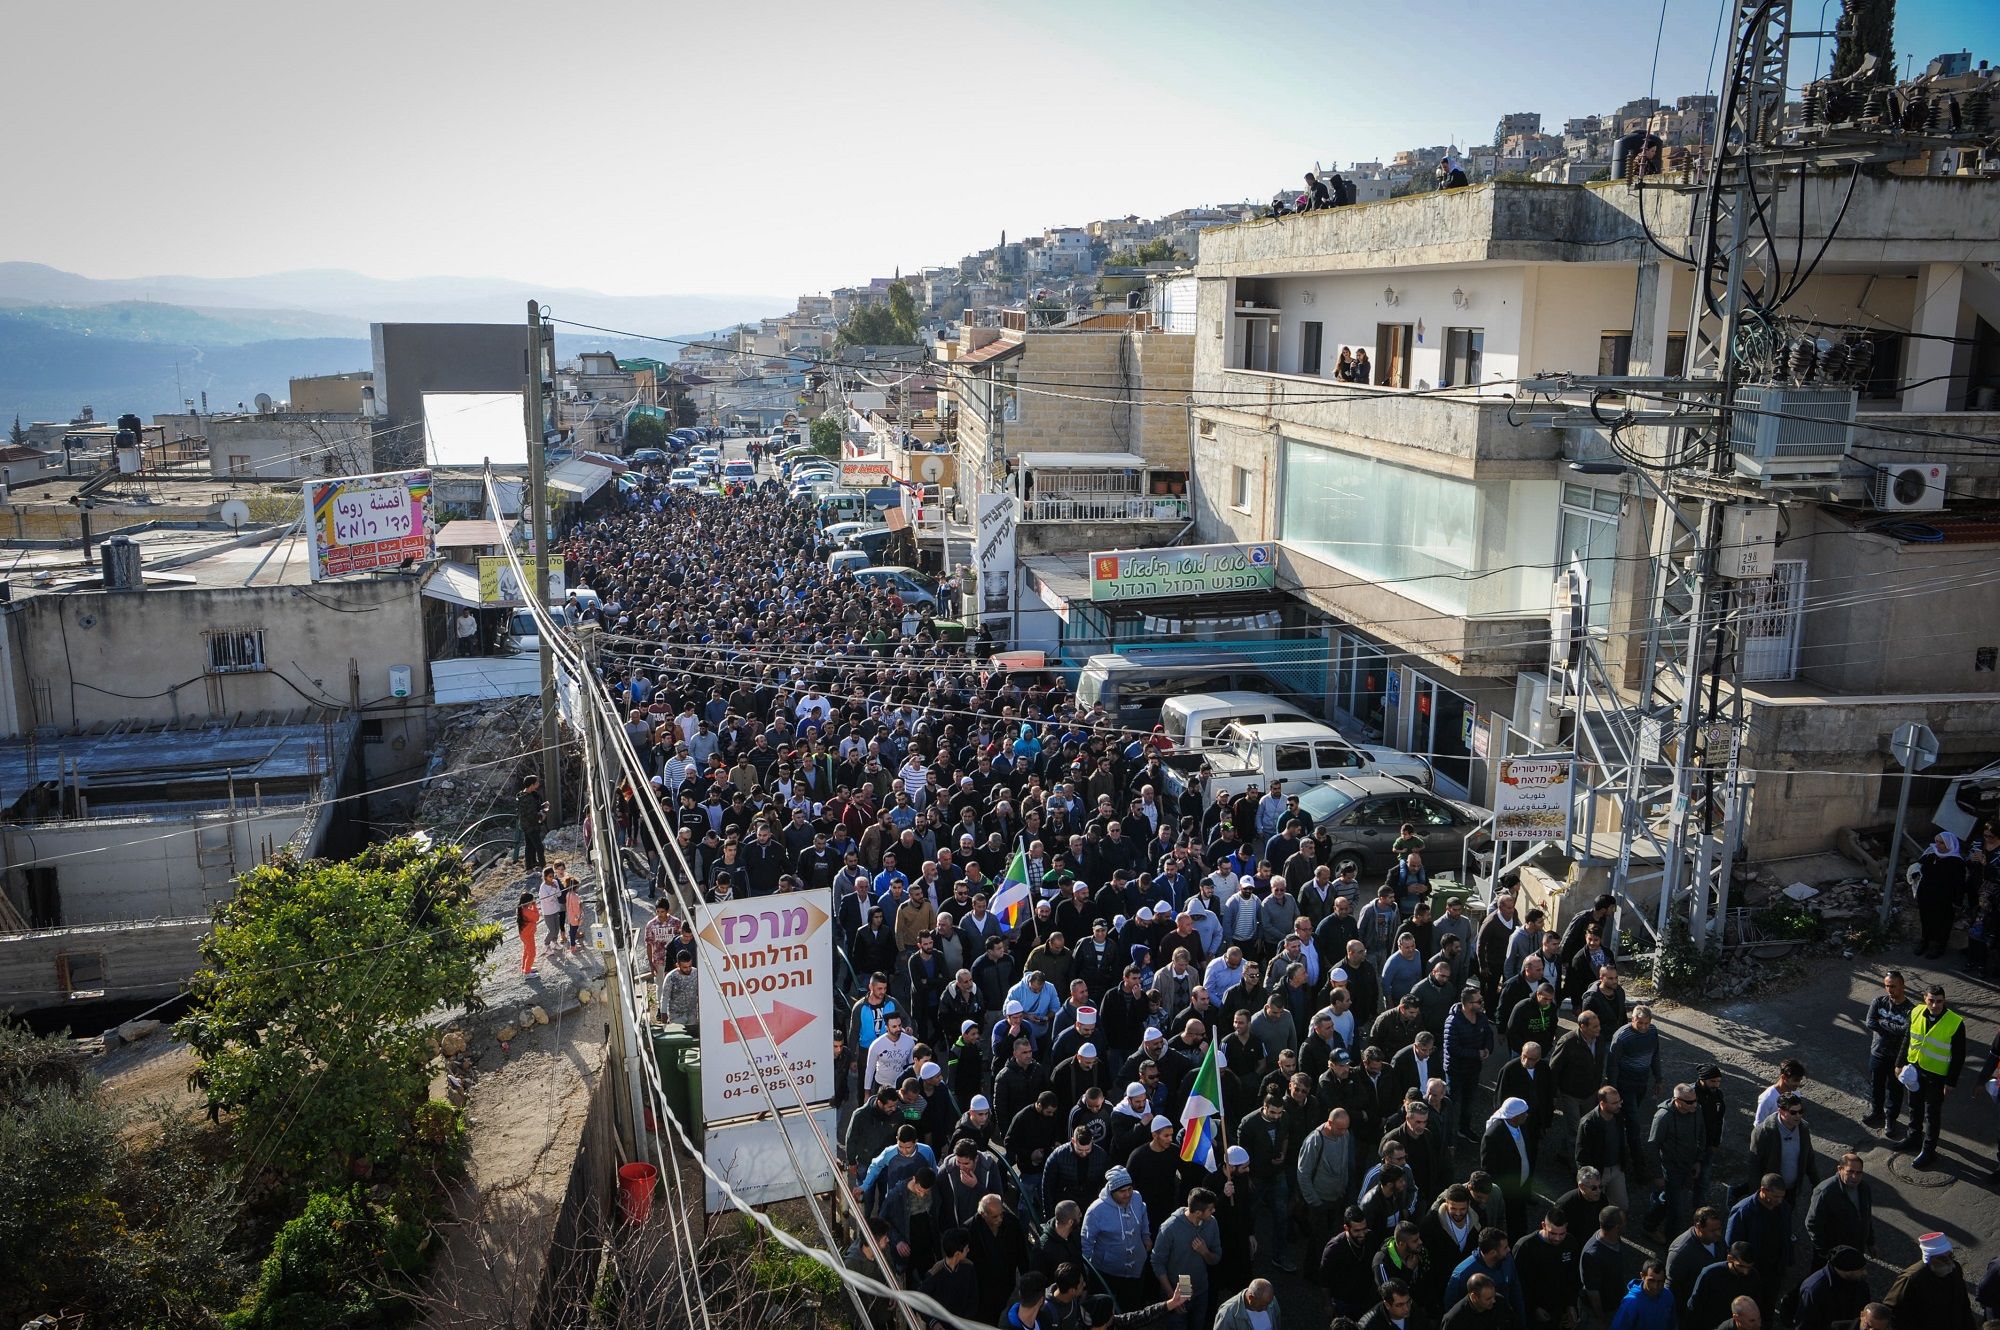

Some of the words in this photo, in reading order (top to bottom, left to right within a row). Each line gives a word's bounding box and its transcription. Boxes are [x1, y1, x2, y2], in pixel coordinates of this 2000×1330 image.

[337, 499, 362, 518] روما
[336, 518, 377, 539] רומא
[386, 515, 410, 531] בדי
[381, 554, 398, 563] צמר
[1213, 555, 1245, 571] טוטו
[1109, 581, 1156, 597] הגדול
[1162, 577, 1204, 592] המזל
[1211, 575, 1257, 590] מפגש
[1512, 765, 1557, 774] קונדיטוריה
[721, 906, 808, 945] מרכז
[723, 944, 808, 972] הדלתות
[720, 969, 812, 997] והכספות
[723, 1074, 814, 1099] 04-68530
